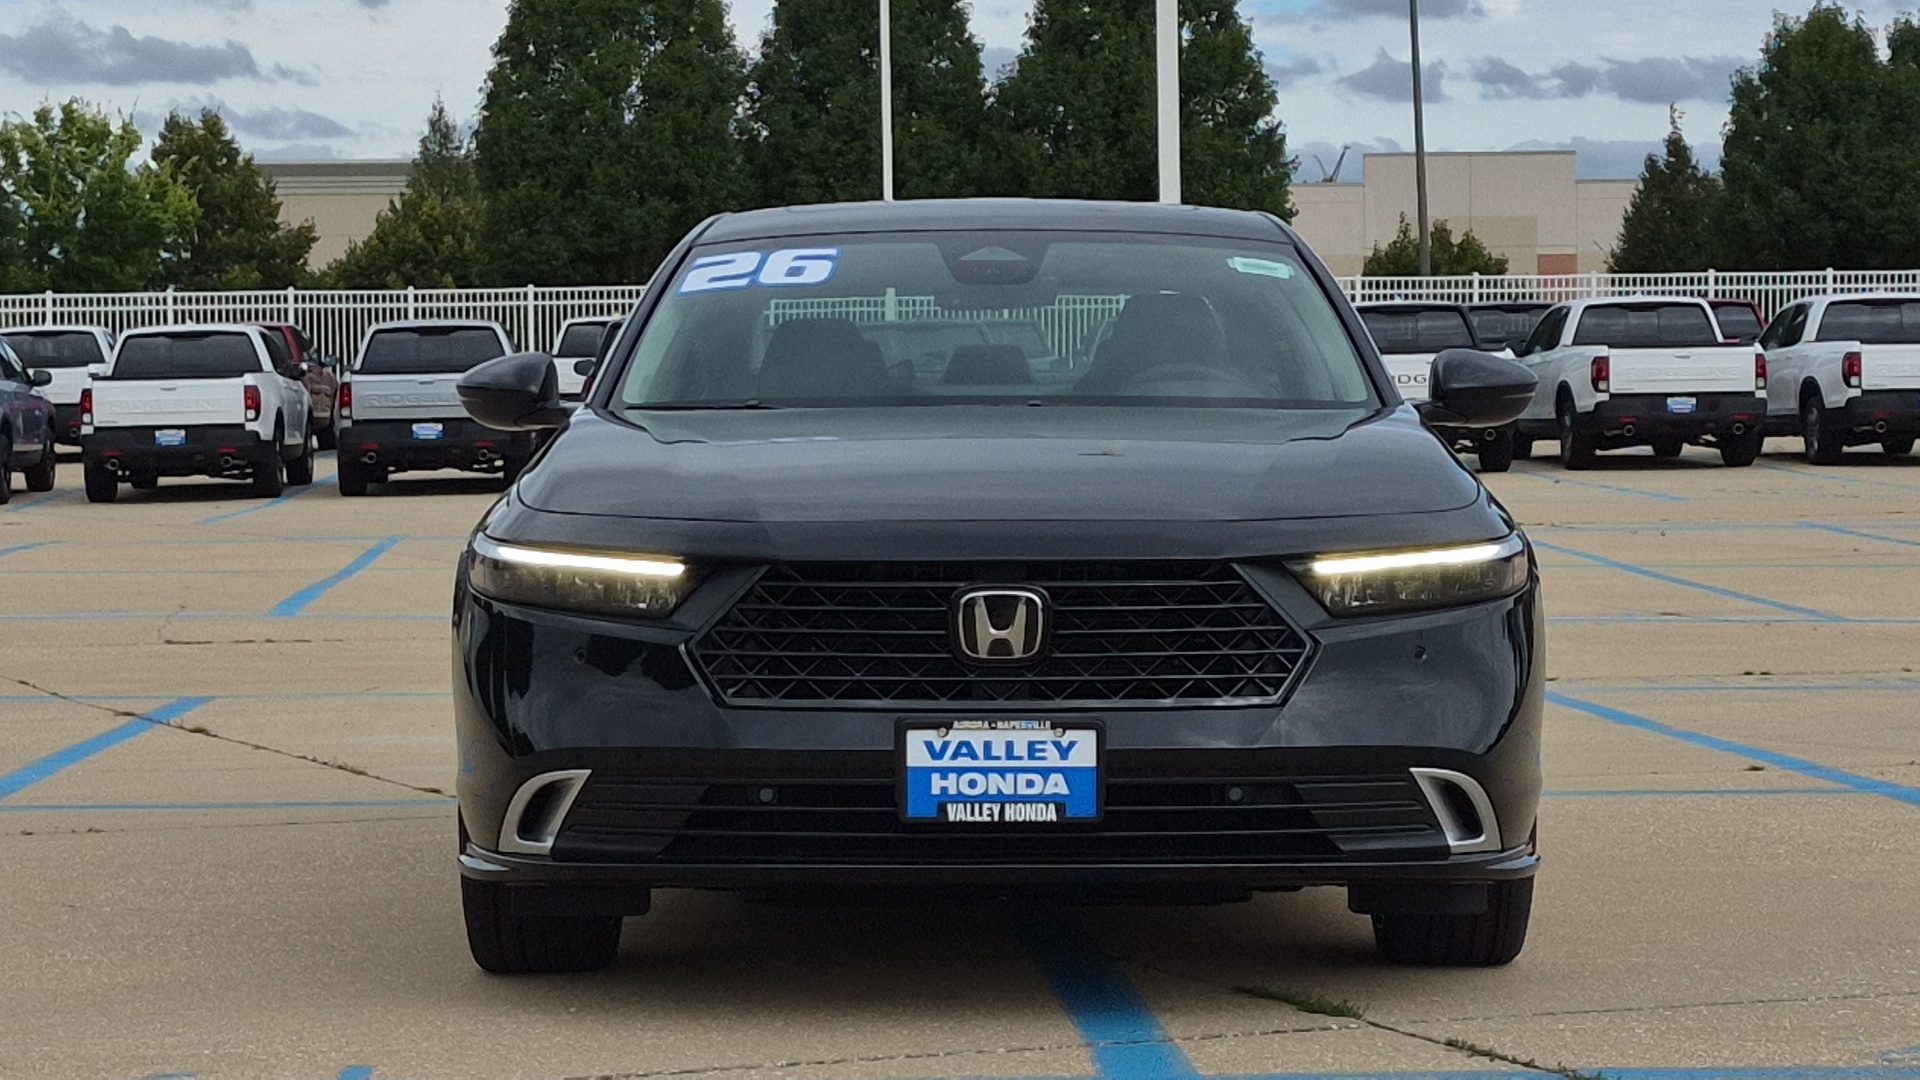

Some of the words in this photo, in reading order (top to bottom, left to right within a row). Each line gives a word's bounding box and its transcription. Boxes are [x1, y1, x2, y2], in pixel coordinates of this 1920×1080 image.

[679, 246, 841, 295] 26
[923, 740, 1079, 761] VALLEY
[930, 772, 1070, 795] HONDA
[947, 803, 1000, 822] VALLEY
[1004, 803, 1057, 822] HONDA
